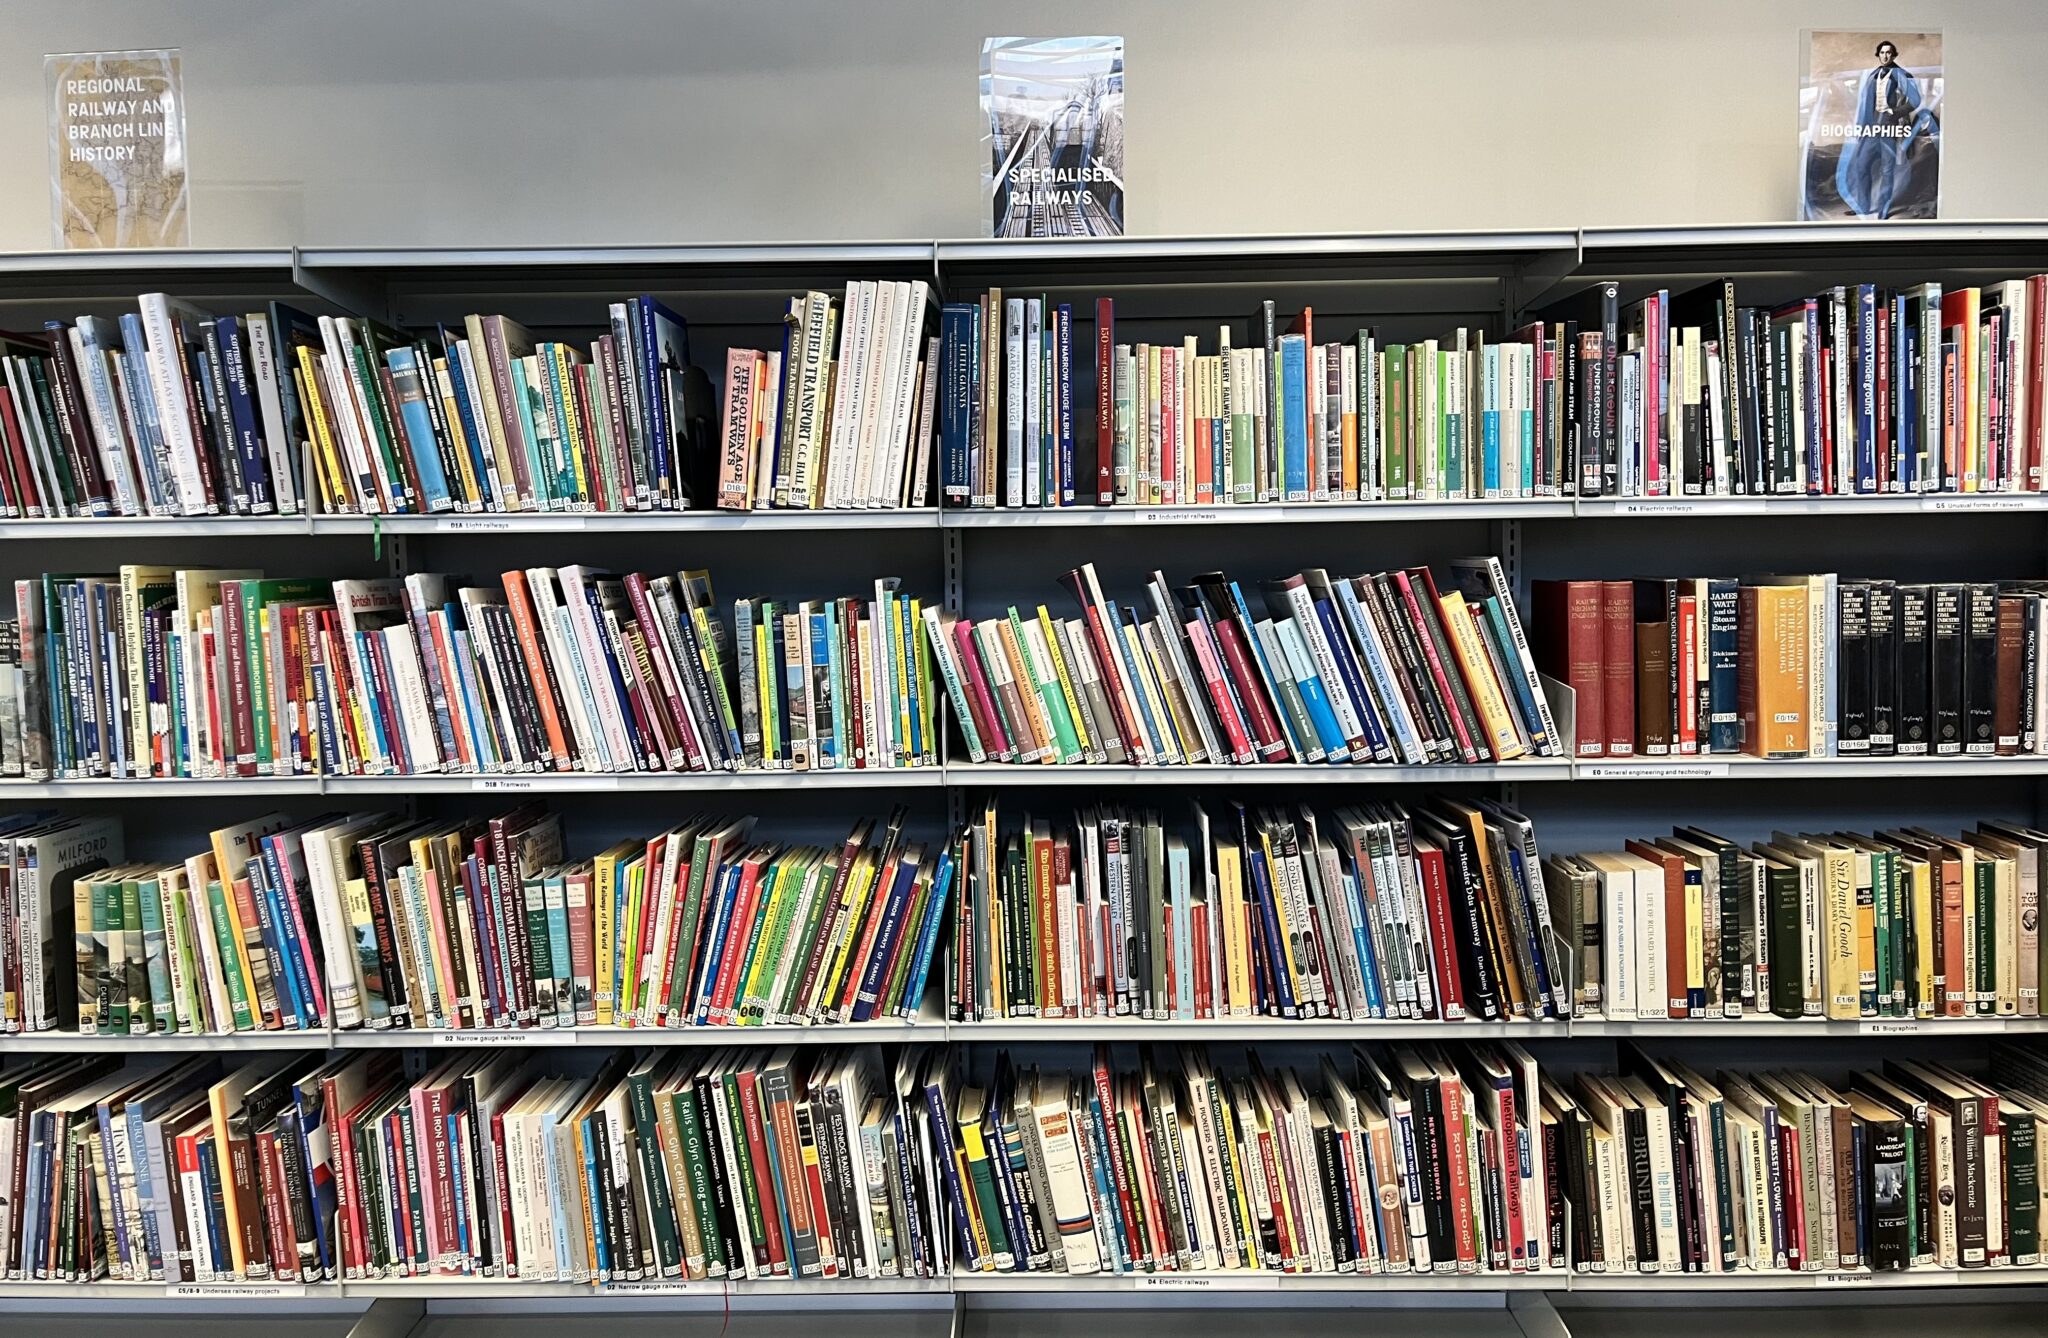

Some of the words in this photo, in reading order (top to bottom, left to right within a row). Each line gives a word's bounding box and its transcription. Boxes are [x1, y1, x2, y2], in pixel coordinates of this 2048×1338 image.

[67, 78, 145, 94] REGIONAL
[68, 101, 137, 117] RAILWAY
[142, 99, 175, 114] AND
[69, 123, 134, 140] BRANCH
[138, 121, 174, 137] LINE
[1821, 125, 1912, 138] BIOGRAPHIES
[70, 145, 136, 161] HISTORY
[1009, 167, 1114, 183] SPECIALISED
[1010, 190, 1093, 205] RAILWAYS
[207, 333, 218, 365] VANISHED
[1100, 327, 1109, 343] 150
[226, 350, 237, 382] 1923-2016
[230, 335, 240, 364] SCOTTISH
[235, 365, 247, 395] RAILWAYS
[1061, 340, 1069, 376] NARROW
[212, 365, 224, 398] RAILWAYS
[733, 366, 741, 384] OF
[741, 367, 749, 393] THE
[787, 364, 799, 420] TRANSPORT
[959, 375, 967, 409] GIANTS
[1062, 377, 1070, 409] GAUGE
[1223, 387, 1231, 425] RAILWAYS
[1593, 363, 1602, 438] UNDERGROUND
[221, 405, 231, 425] WEST
[728, 386, 741, 466] TRAMWAYS
[736, 395, 748, 452] GOLDEN
[224, 426, 235, 450] LOTHIAN
[734, 456, 744, 482] AGE
[1191, 513, 1216, 521] railways
[1666, 505, 1692, 513] railways
[466, 522, 482, 530] Light
[484, 522, 509, 530] railways
[309, 611, 317, 646] PROUDLOCK
[1670, 615, 1679, 666] ENGINEERING
[1712, 624, 1738, 632] Engine
[311, 648, 319, 662] NOEL
[68, 661, 78, 698] CARDIFF
[684, 626, 692, 636] THE
[688, 636, 700, 666] KINVER
[697, 667, 707, 688] LIGHT
[704, 689, 716, 720] RAILWAY
[1529, 671, 1538, 688] Peaty
[2027, 661, 2035, 687] RAILWAY
[80, 680, 89, 723] NEWPORT
[2026, 688, 2034, 729] ENGINEERING
[1678, 769, 1712, 777] technology
[58, 837, 108, 864] MILFORD
[478, 858, 488, 887] CORRIS
[19, 872, 28, 910] WHITLAND
[361, 843, 377, 883] NARROW
[369, 886, 381, 916] GAUGE
[375, 917, 393, 965] RAILWAYS
[890, 896, 901, 917] MINOR
[880, 920, 894, 950] RAILWAYS
[867, 963, 880, 986] FRANCE
[1965, 958, 1974, 993] Engineers
[500, 1034, 526, 1042] railways
[1883, 1025, 1918, 1033] Biographies
[431, 1093, 441, 1113] THE
[433, 1114, 443, 1139] IRON
[834, 1114, 847, 1151] FESTINIOG
[1099, 1082, 1115, 1125] LONDON'S
[1108, 1125, 1128, 1193] UNDERGROUND
[1167, 1113, 1183, 1172] ELECTRIFYING
[1502, 1095, 1515, 1168] Metropolitan
[1803, 1113, 1812, 1155] BENJAMIN
[113, 1127, 127, 1168] TUNNEL
[132, 1114, 150, 1184] EUROTUNNEL
[331, 1132, 342, 1176] FESTINIOG
[435, 1140, 447, 1179] SHERPA
[1966, 1127, 1975, 1166] William
[840, 1152, 852, 1189] RAILWAY
[1449, 1090, 1459, 1121] THE
[1460, 1198, 1470, 1251] STORY
[1633, 1135, 1650, 1210] BRUNEL
[1770, 1138, 1782, 1213] BASSETT-LOWKE
[1806, 1157, 1815, 1192] OUTRAM
[336, 1177, 346, 1206] RAILWAY
[1507, 1171, 1519, 1219] Railways
[1967, 1166, 1976, 1209] Mackenzie
[232, 1288, 255, 1296] railway
[257, 1288, 280, 1296] projects
[642, 1284, 661, 1292] gauge
[662, 1283, 687, 1291] railways
